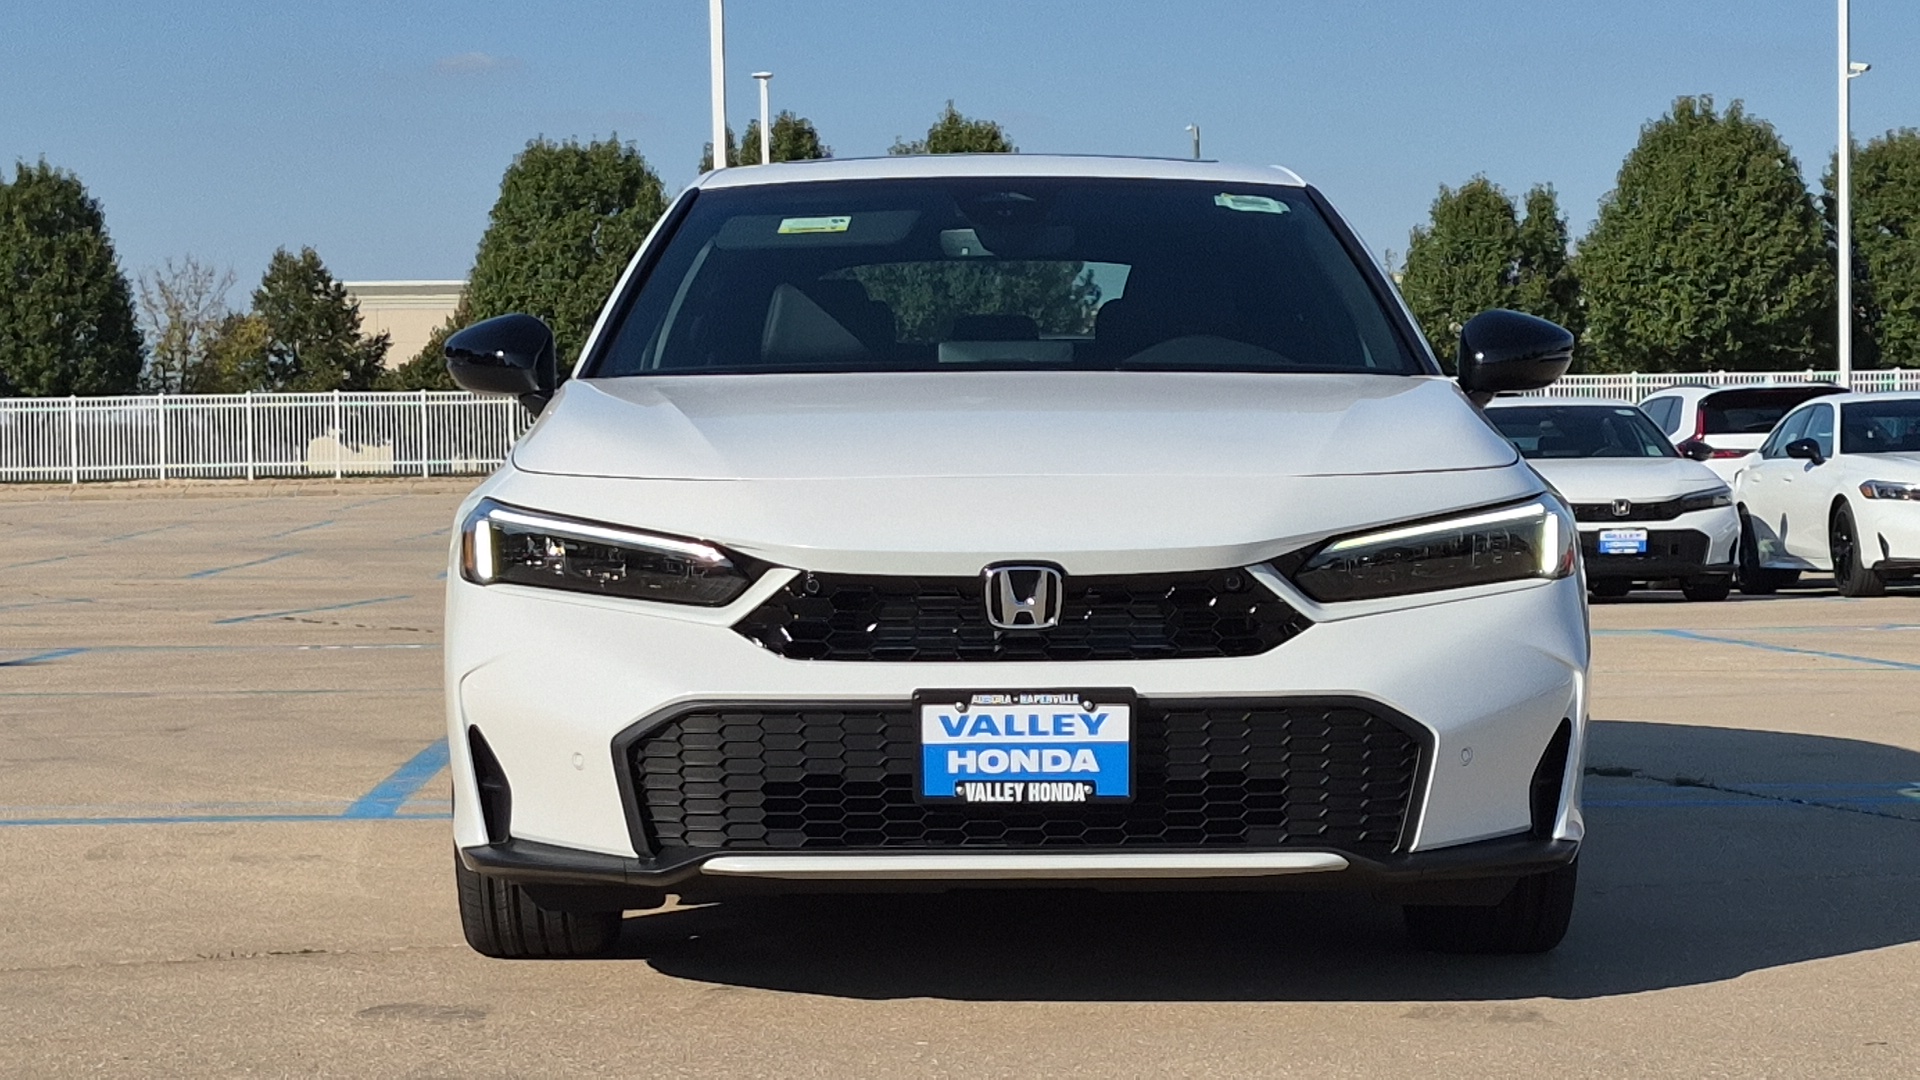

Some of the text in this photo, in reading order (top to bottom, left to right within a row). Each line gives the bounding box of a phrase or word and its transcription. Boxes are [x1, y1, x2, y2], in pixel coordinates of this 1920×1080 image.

[938, 713, 1109, 737] VALLEY
[947, 749, 1100, 774] HONDA
[965, 782, 1086, 802] VALLEY HONDA
